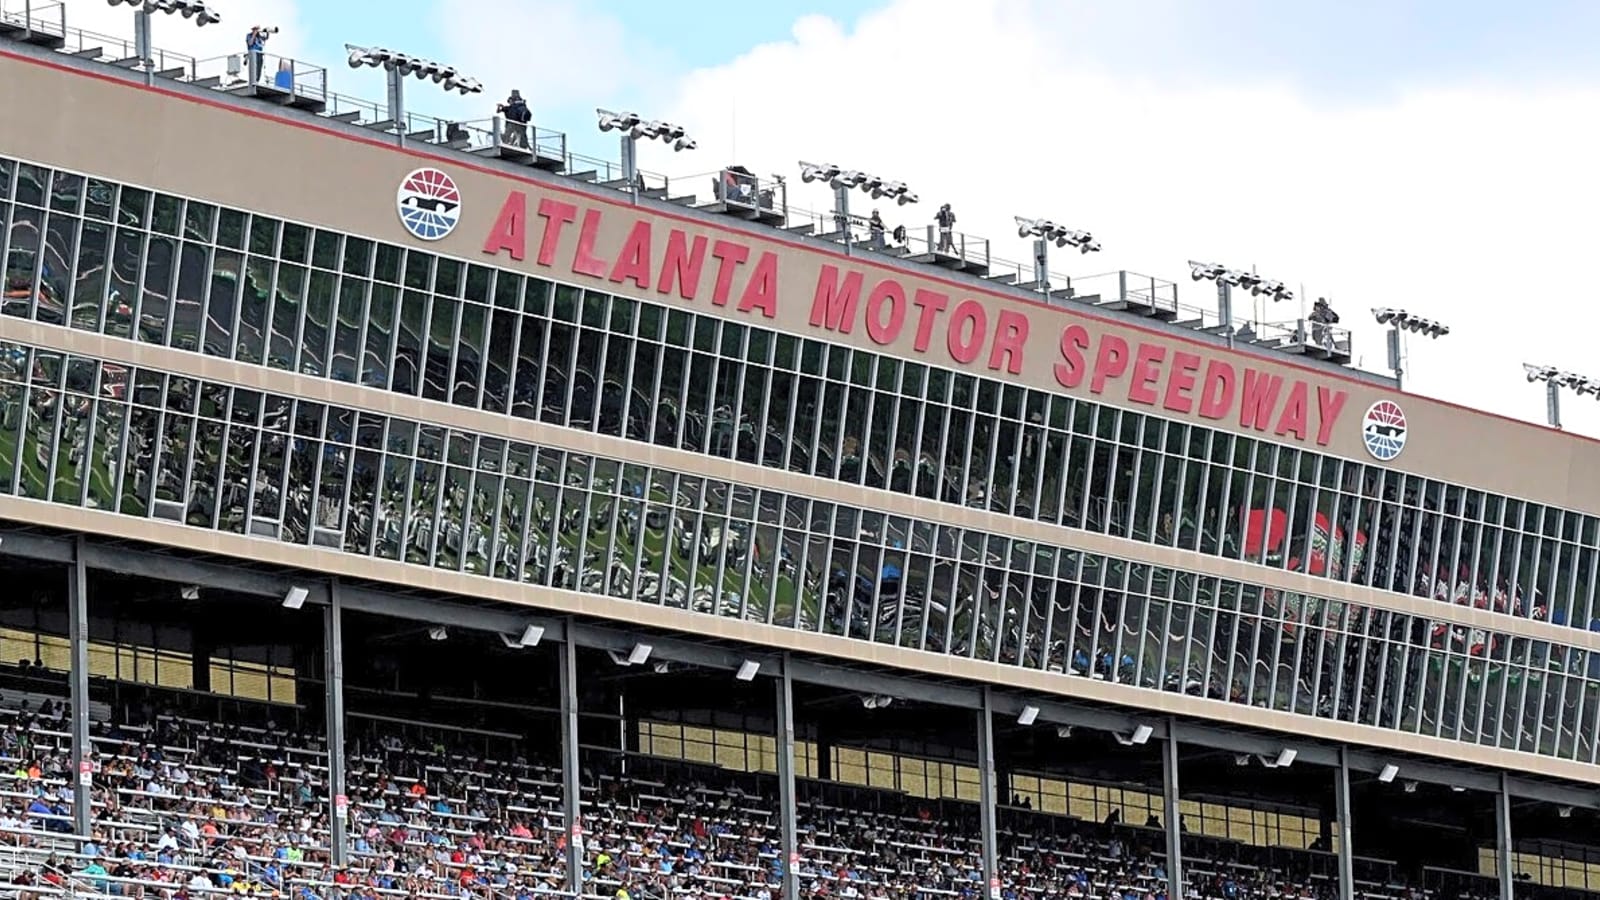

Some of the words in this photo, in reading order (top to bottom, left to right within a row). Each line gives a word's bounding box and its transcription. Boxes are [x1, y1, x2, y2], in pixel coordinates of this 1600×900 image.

[484, 190, 778, 318] ATLANTA
[810, 263, 1030, 375] MOTOR
[1054, 324, 1349, 445] SPEEDWAY
